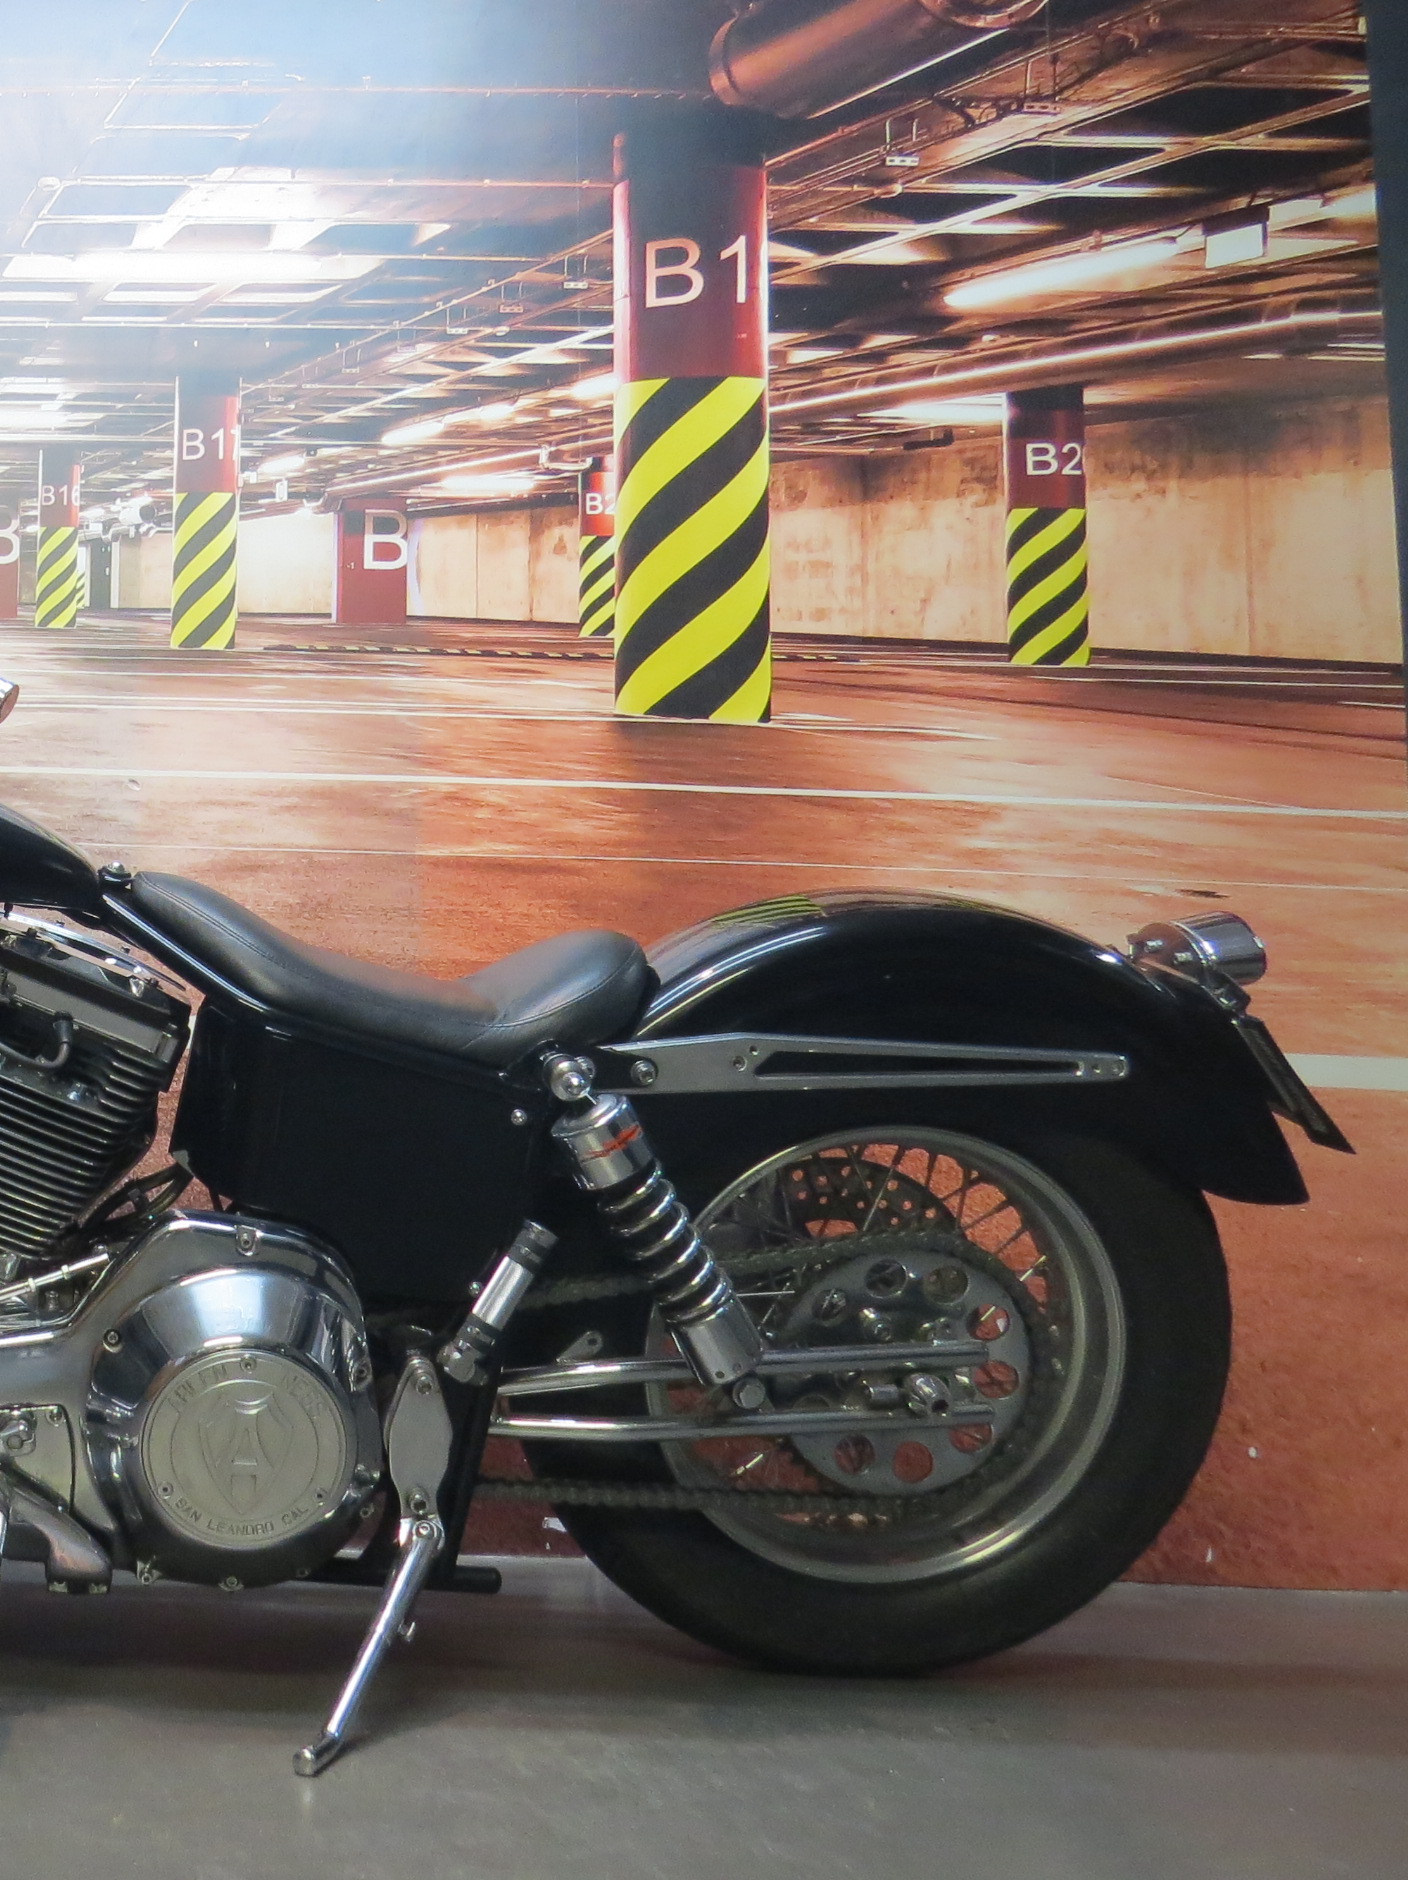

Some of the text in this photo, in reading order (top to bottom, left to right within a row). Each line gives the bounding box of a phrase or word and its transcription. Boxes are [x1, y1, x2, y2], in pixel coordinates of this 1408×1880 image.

[645, 234, 747, 308] B1
[1026, 443, 1082, 476] B2
[363, 509, 408, 570] B
[207, 1517, 275, 1536] LEANDRO
